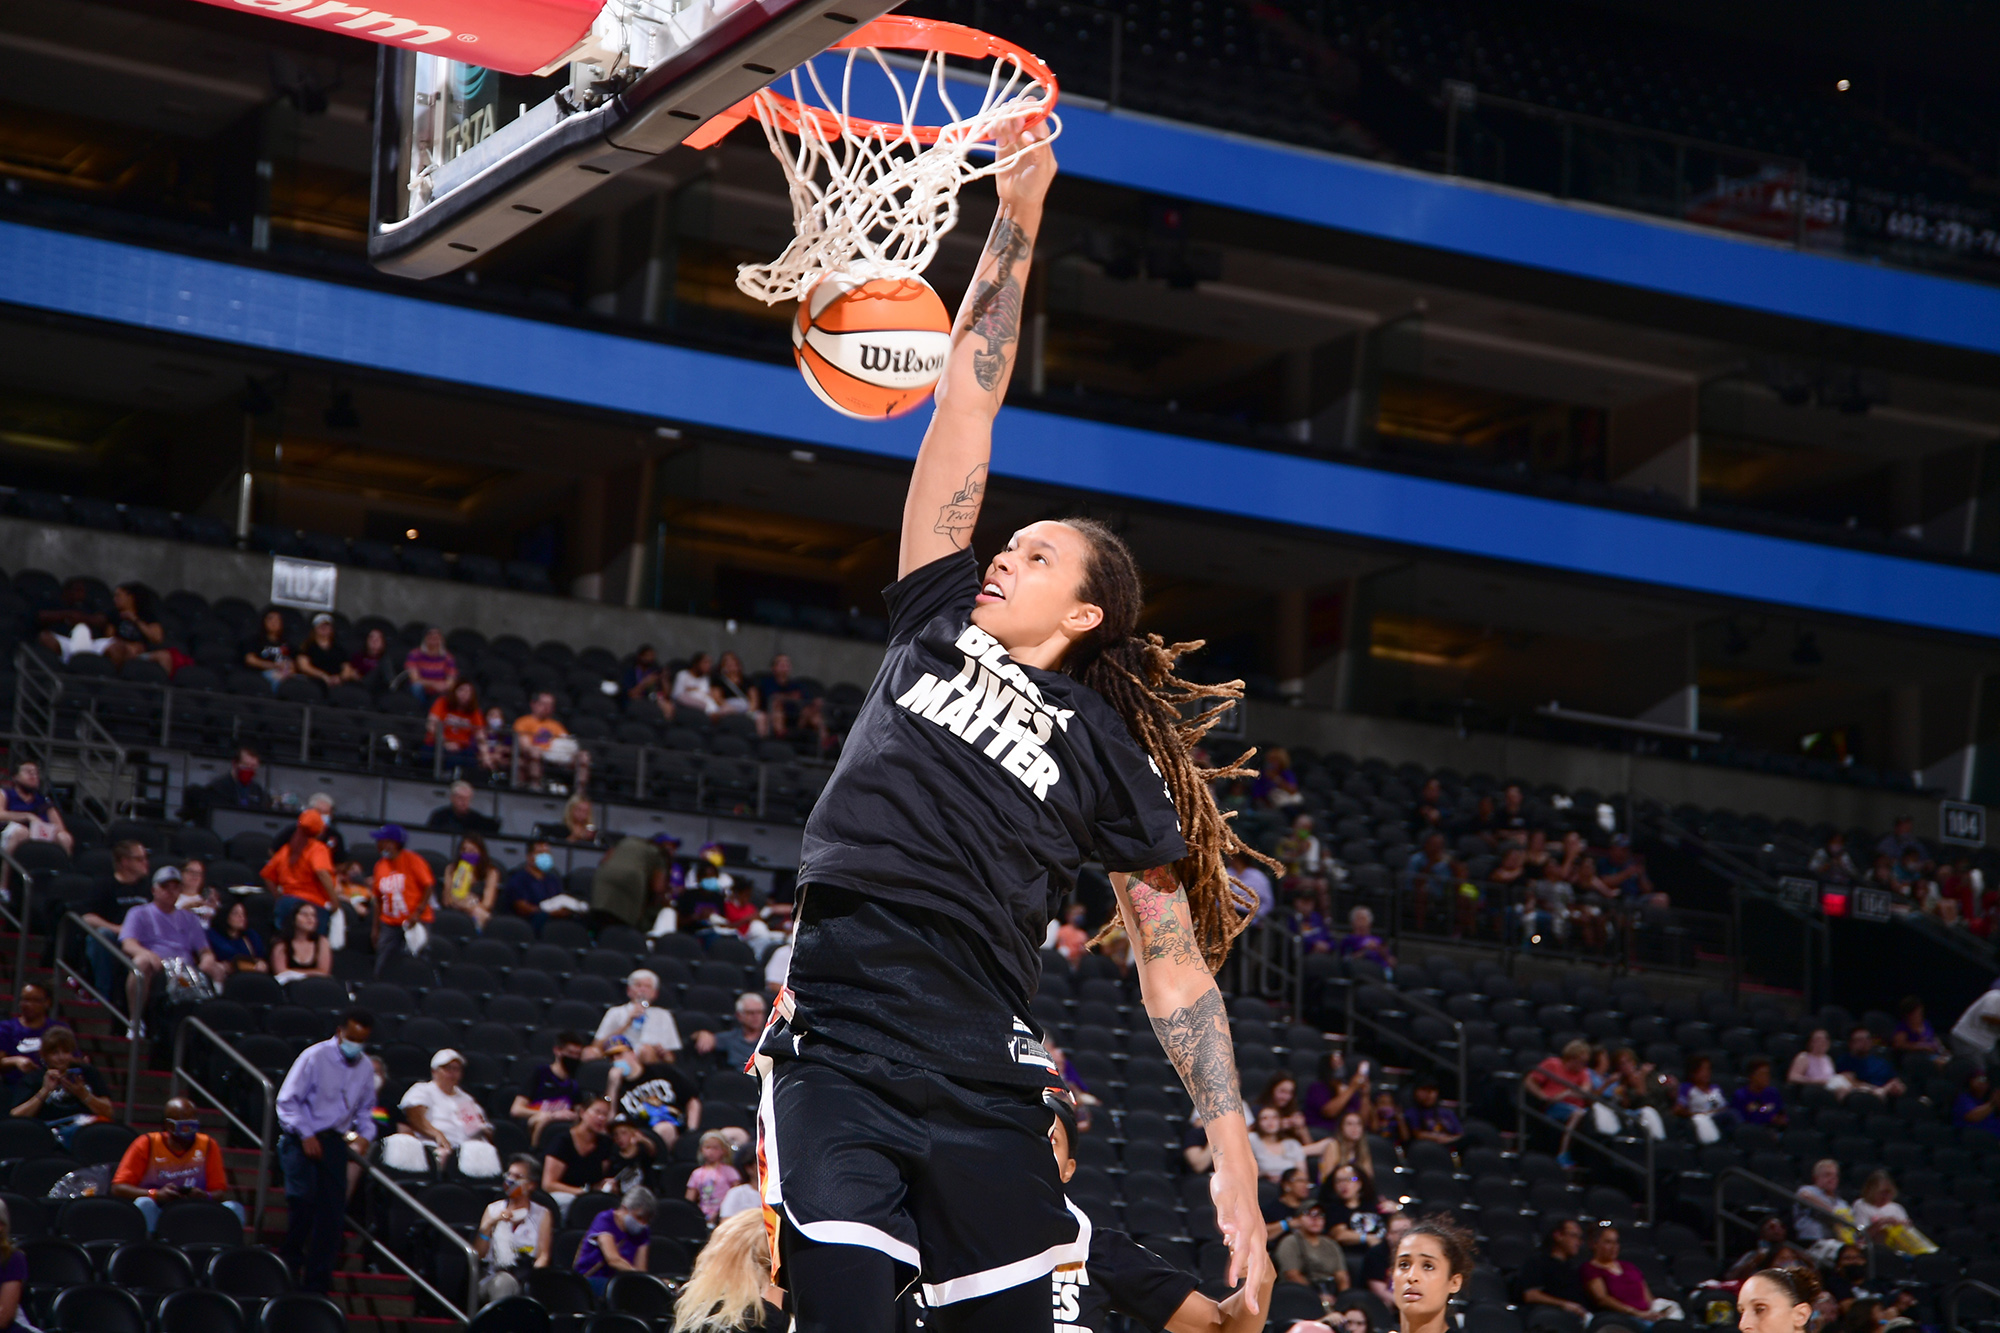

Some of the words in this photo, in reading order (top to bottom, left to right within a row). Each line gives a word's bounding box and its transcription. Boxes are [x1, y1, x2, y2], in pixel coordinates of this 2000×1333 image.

[860, 343, 945, 373] Wilson
[949, 655, 1053, 746] LIVES
[954, 624, 1076, 733] BLACK
[895, 672, 1061, 802] MATTER
